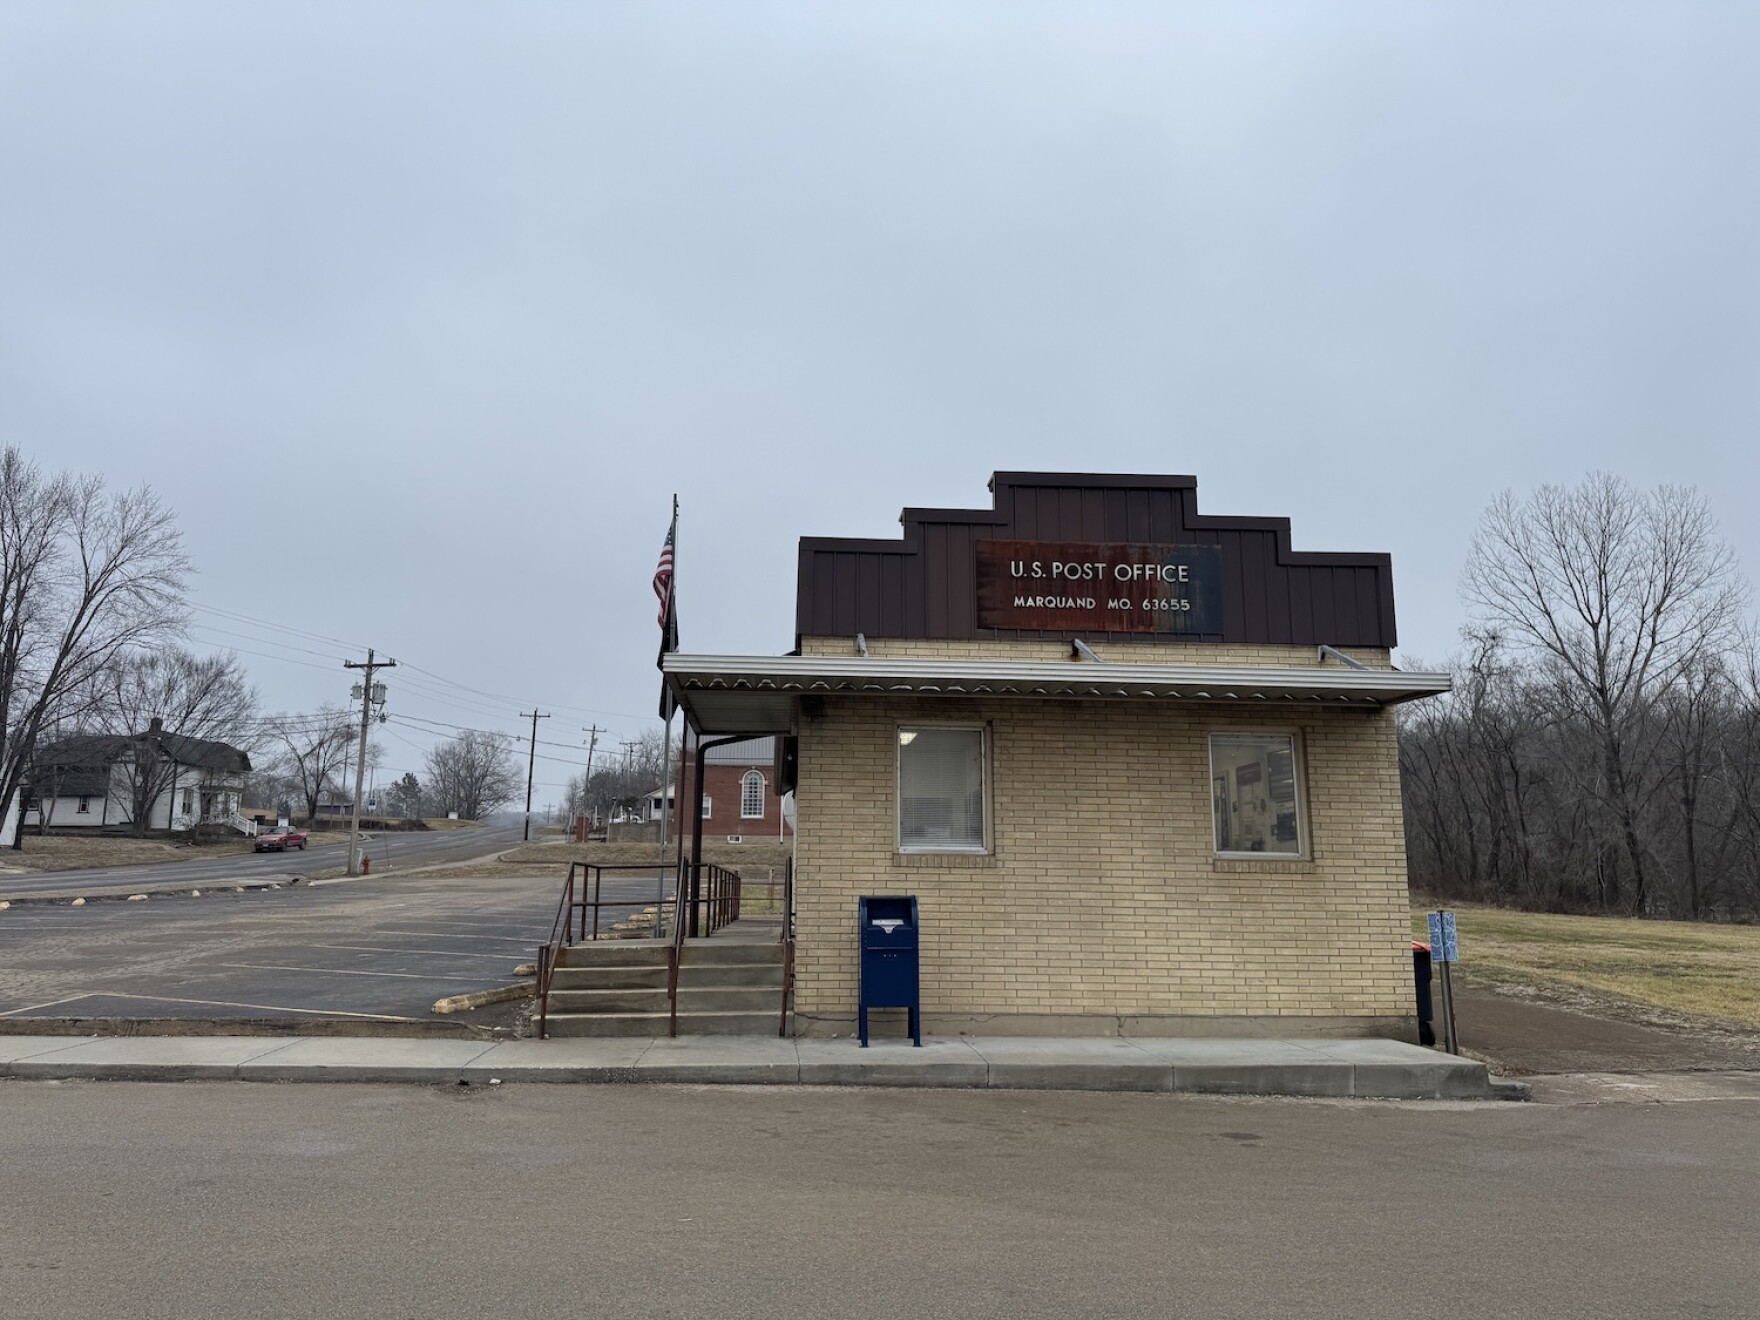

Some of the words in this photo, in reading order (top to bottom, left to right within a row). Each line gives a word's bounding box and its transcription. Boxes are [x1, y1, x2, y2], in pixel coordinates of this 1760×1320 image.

[1010, 560, 1046, 579] U.S.
[1052, 562, 1106, 580] POST
[1114, 564, 1189, 582] OFFICE
[1013, 596, 1096, 610] MARQUAND
[1107, 598, 1133, 611] MO.
[1142, 598, 1191, 611] 63655
